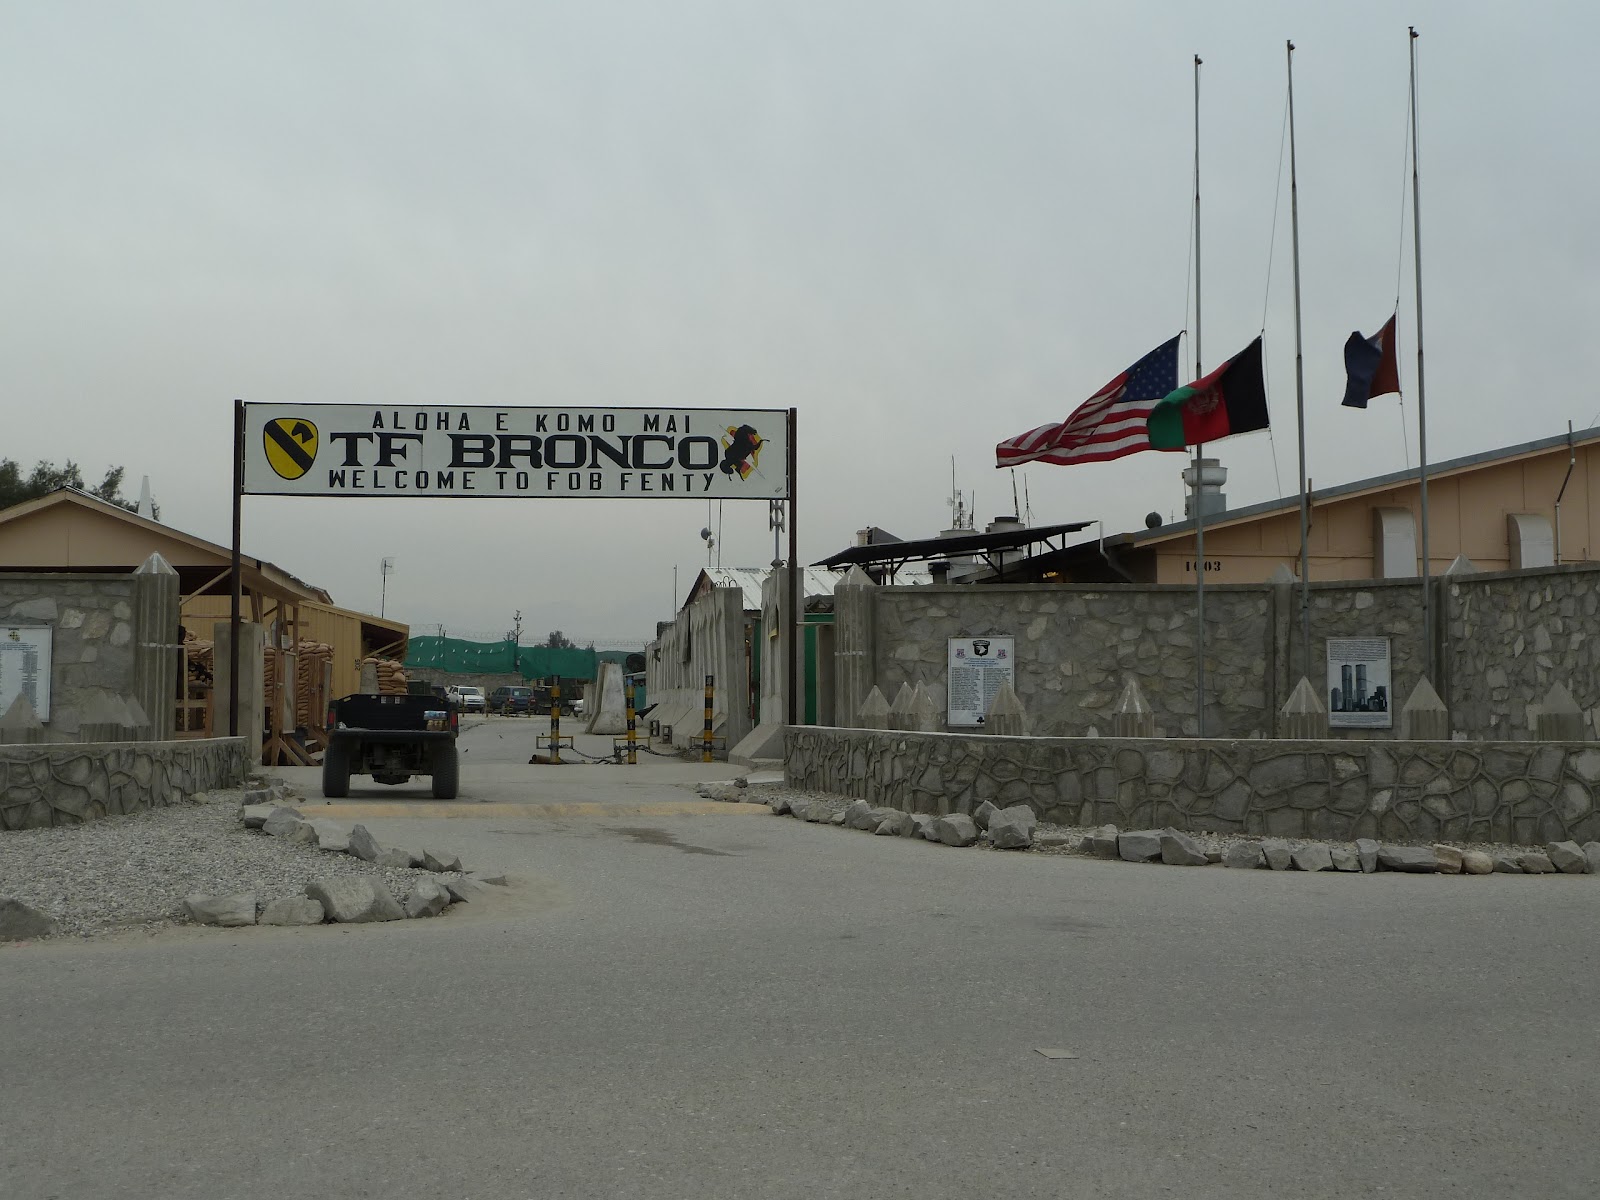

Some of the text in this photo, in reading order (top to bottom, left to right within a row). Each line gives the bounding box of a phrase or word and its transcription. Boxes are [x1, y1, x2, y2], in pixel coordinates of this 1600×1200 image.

[372, 411, 690, 433] ALOHA E KOMO MAI
[330, 432, 718, 470] TF BRONCO
[329, 470, 714, 492] WELCOME TO FOB FENTY
